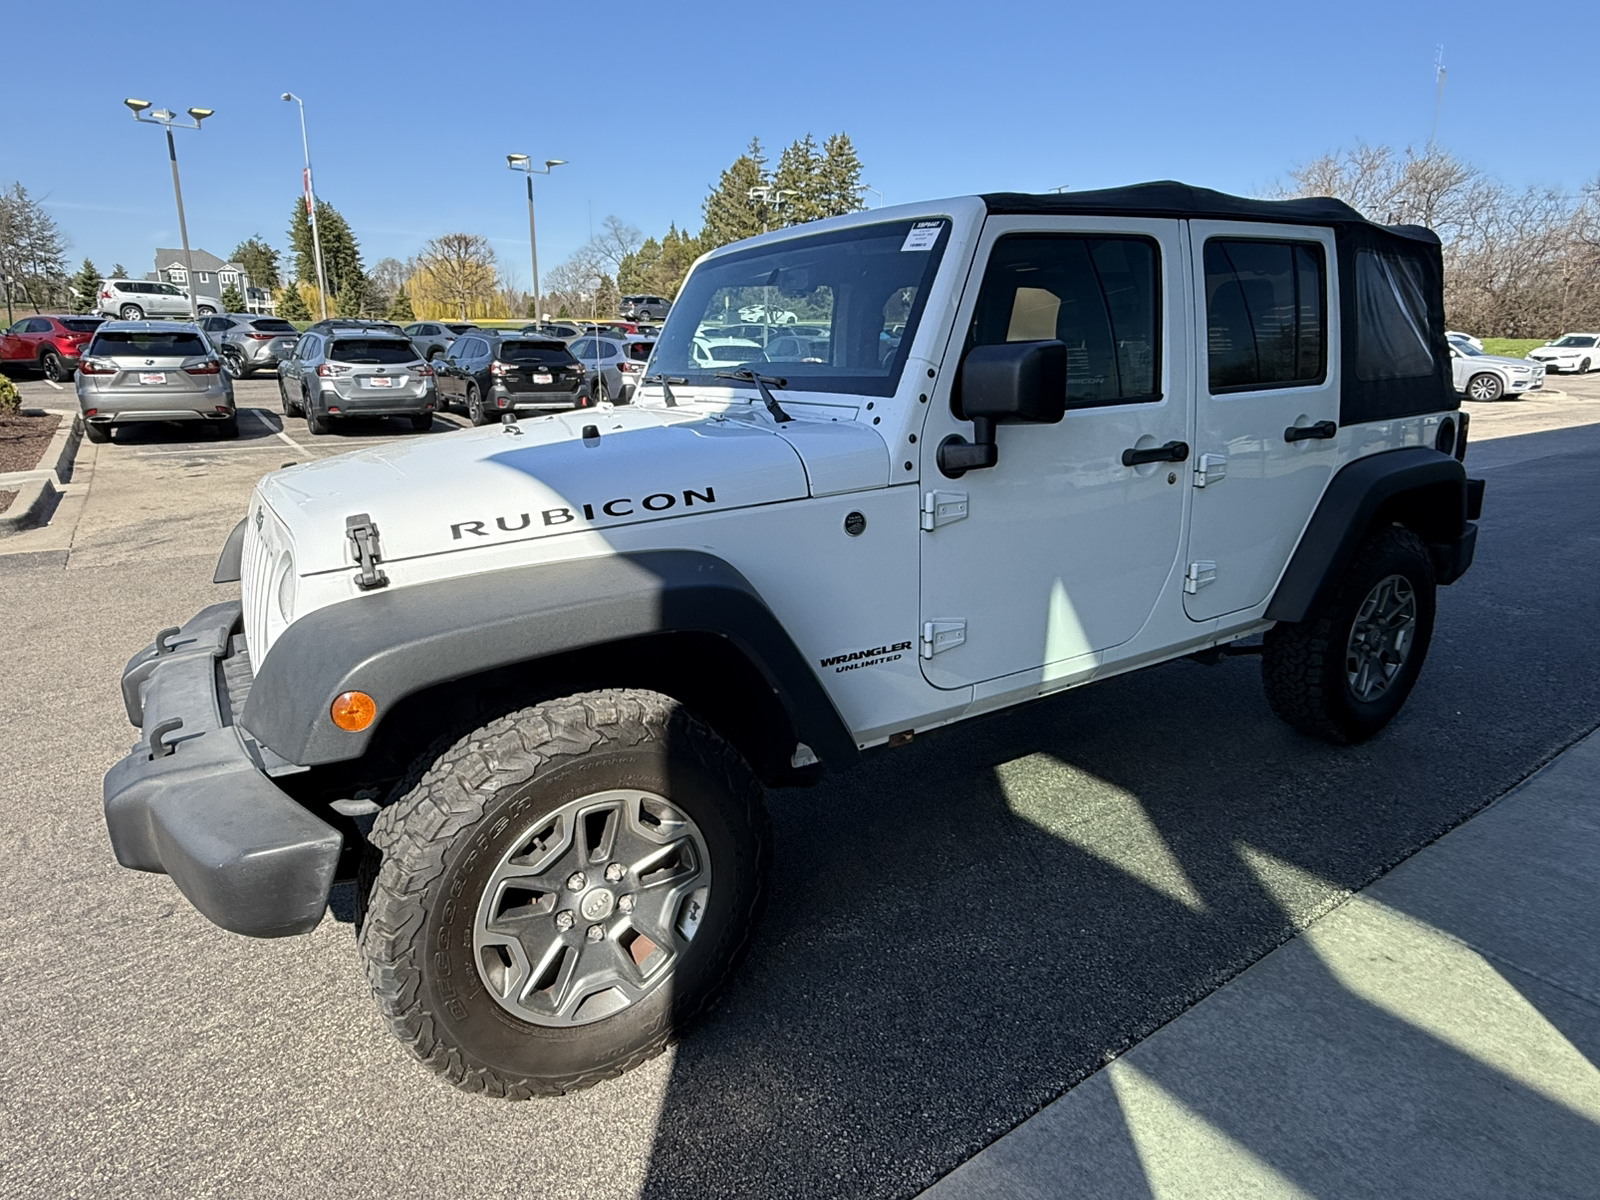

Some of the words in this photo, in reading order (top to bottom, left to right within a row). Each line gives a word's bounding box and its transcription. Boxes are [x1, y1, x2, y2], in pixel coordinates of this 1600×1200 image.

[450, 487, 716, 540] RUBICON
[820, 641, 912, 667] WRANGLER
[836, 654, 902, 673] UNLIMITED
[434, 796, 534, 1022] BFGoodrich
